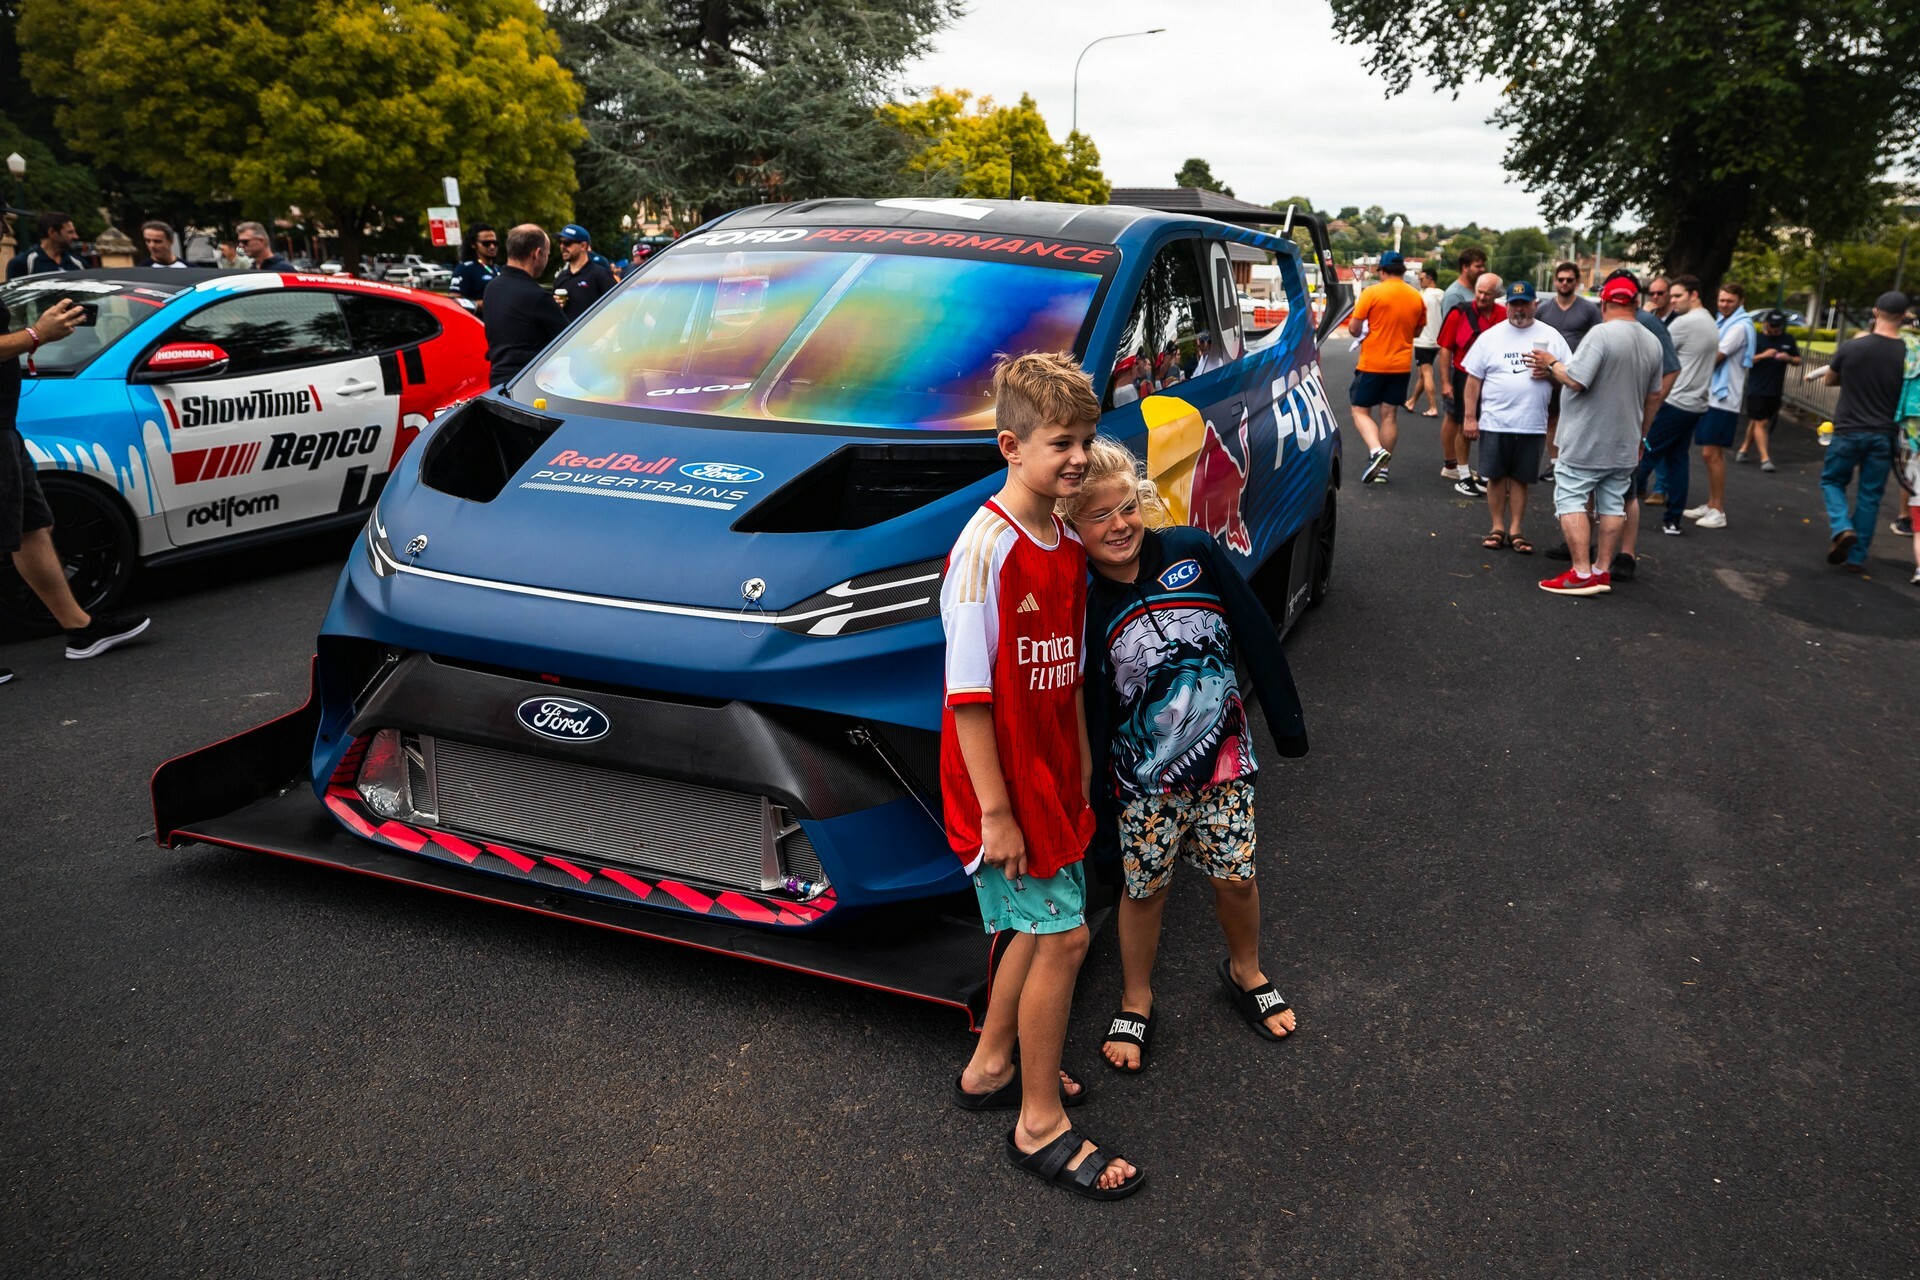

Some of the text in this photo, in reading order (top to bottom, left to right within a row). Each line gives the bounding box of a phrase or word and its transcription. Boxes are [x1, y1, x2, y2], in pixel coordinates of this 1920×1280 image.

[676, 228, 1114, 265] FORD PERFORMANCE
[646, 382, 752, 397] FORD
[181, 388, 310, 429] ShowTime
[262, 424, 382, 472] Repco
[548, 449, 678, 475] Red Bull
[692, 463, 750, 482] Ford
[530, 470, 749, 501] POWERTRAINS
[186, 493, 280, 528] rotiform
[1167, 563, 1196, 586] BCF
[1029, 667, 1055, 690] FLY
[533, 702, 592, 735] Ford
[1254, 988, 1286, 1013] EVERLA
[1108, 1018, 1146, 1043] EVERLAST
